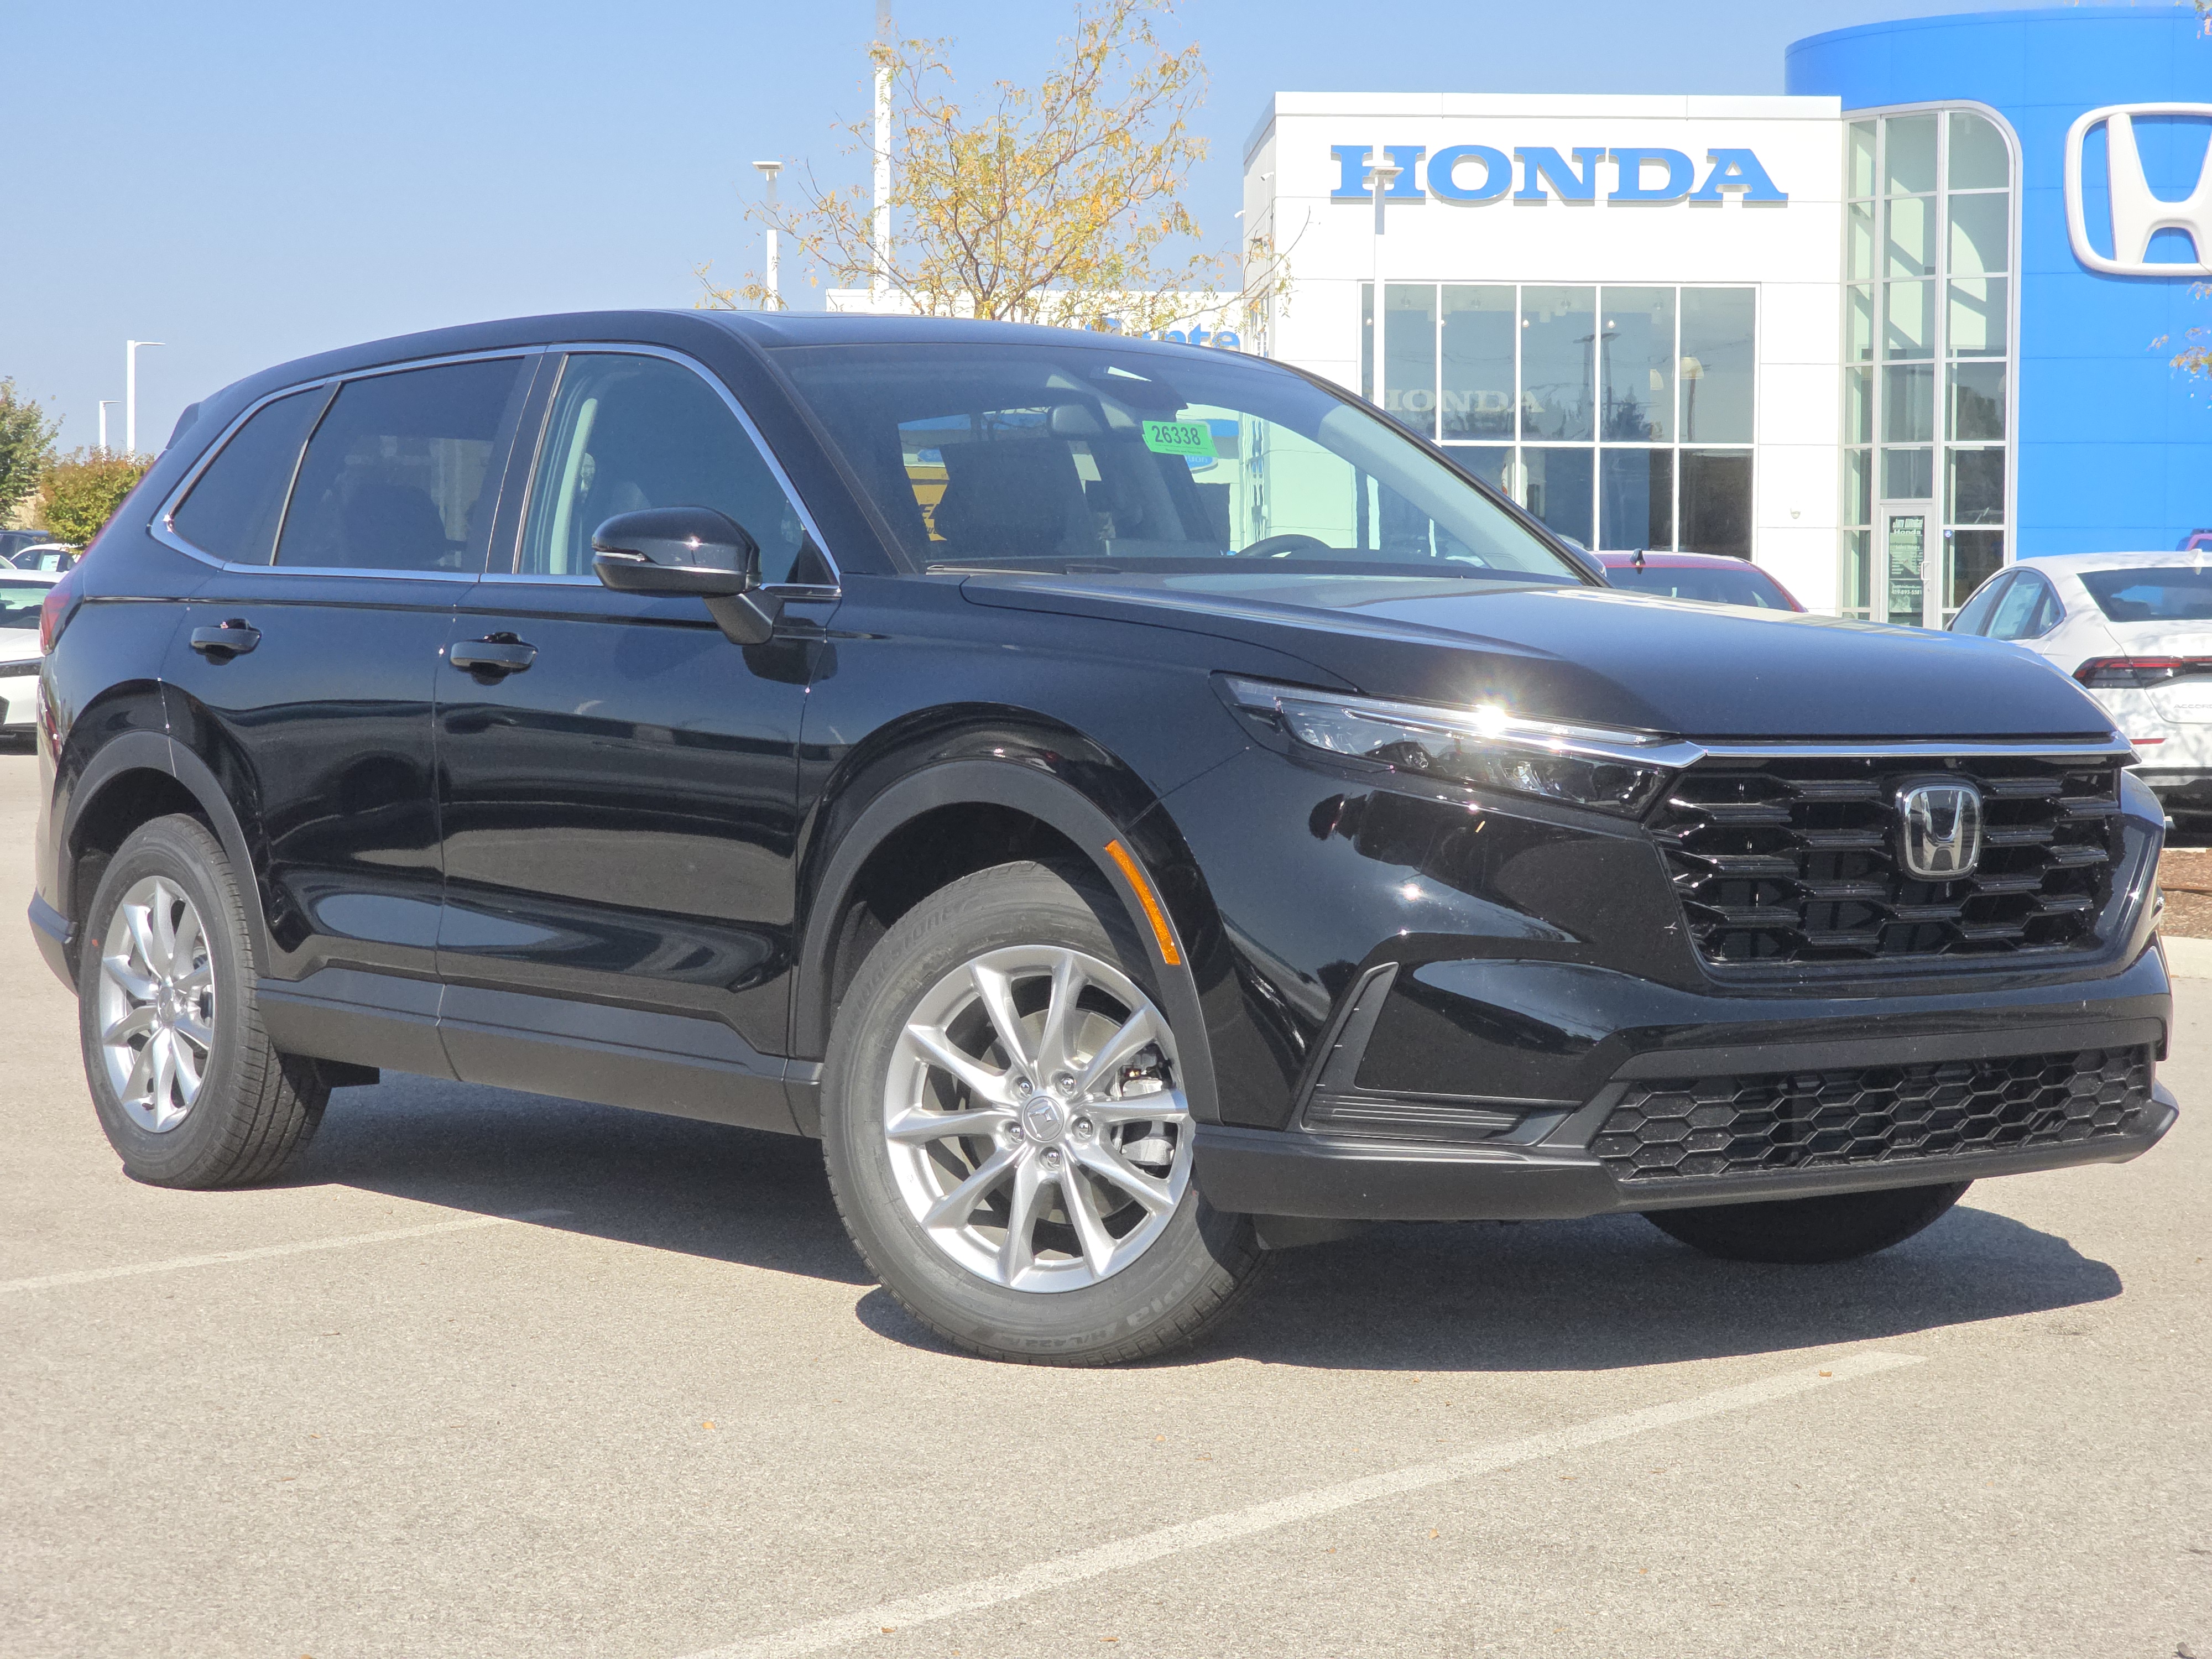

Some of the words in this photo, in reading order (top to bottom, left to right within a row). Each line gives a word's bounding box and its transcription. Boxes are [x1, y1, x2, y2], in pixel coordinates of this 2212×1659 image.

[1331, 144, 1788, 203] HONDA
[1363, 389, 1546, 413] HONDA
[1151, 425, 1201, 445] 26338
